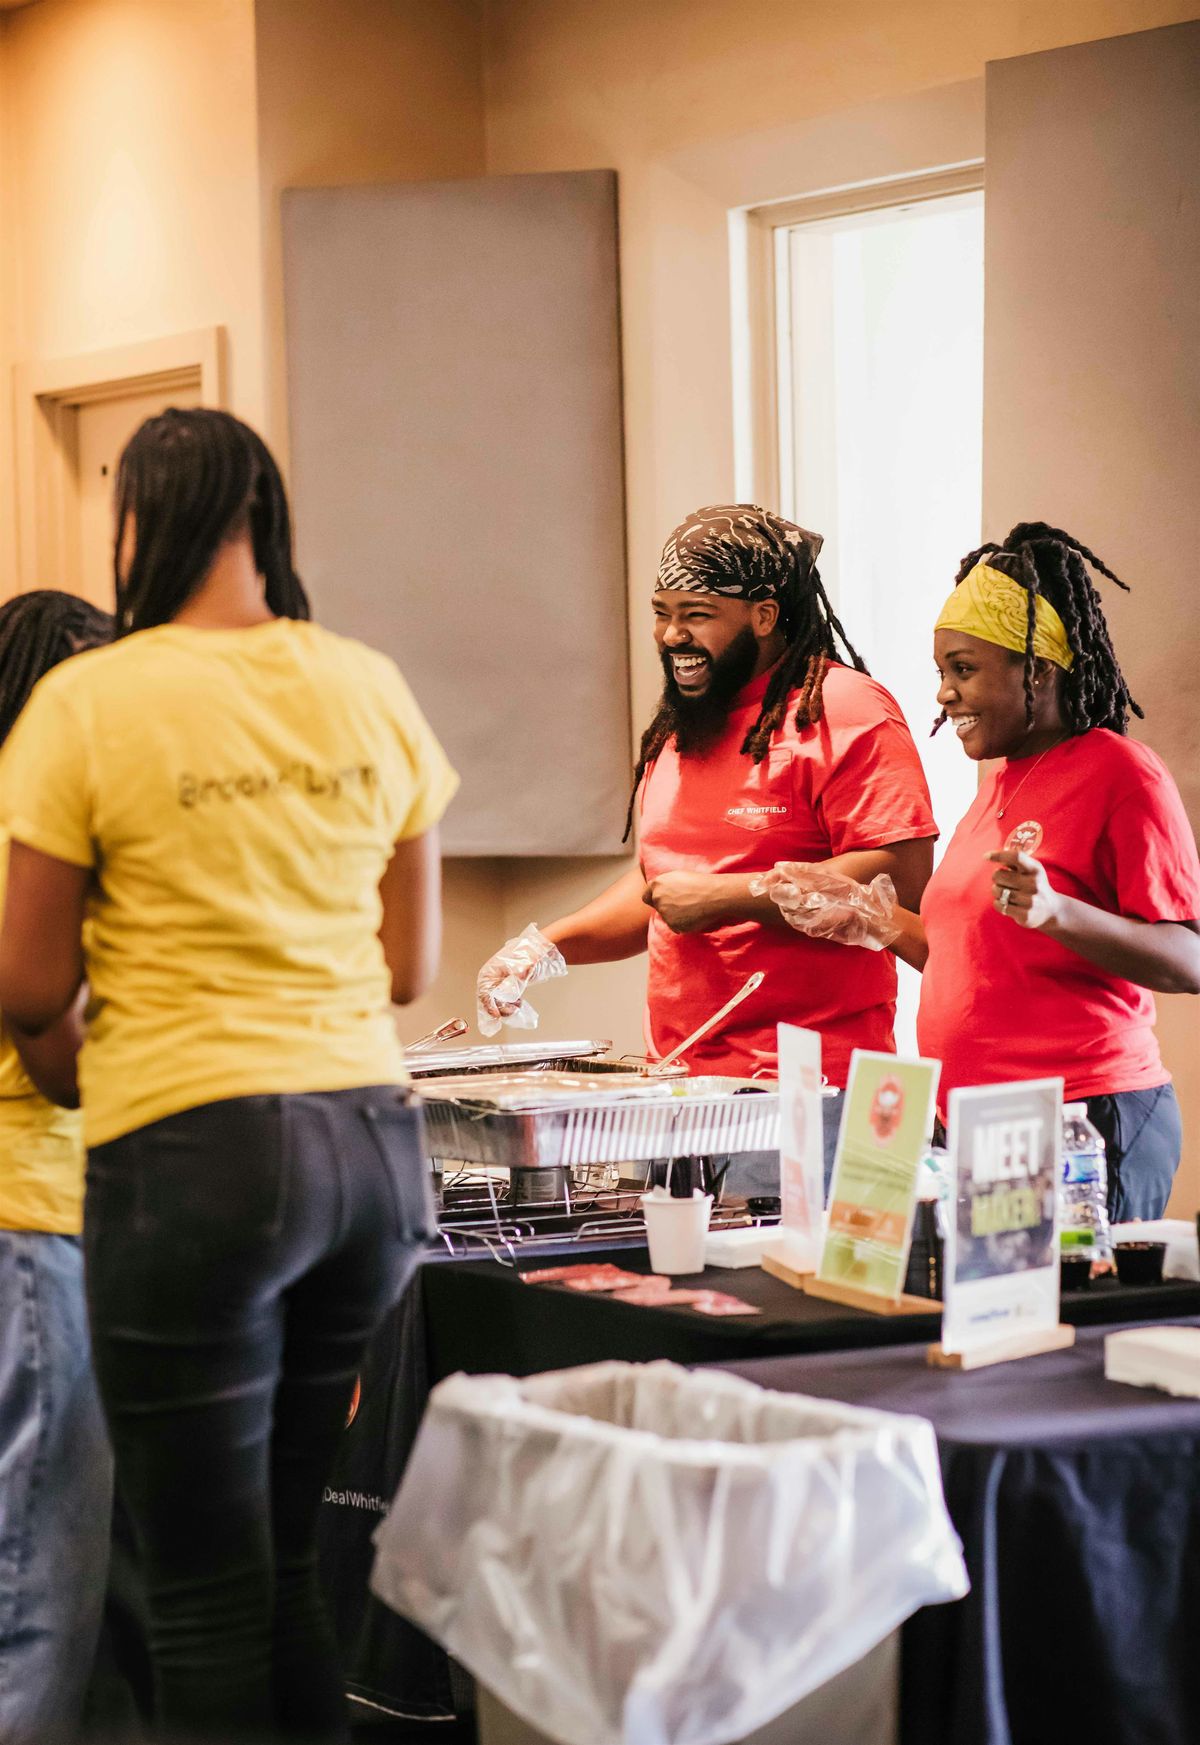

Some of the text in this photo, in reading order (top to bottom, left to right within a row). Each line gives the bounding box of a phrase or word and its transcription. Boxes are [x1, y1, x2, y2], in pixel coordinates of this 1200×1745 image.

[727, 806, 788, 815] CHEF WHITFIELD
[972, 1117, 1043, 1184] MEET
